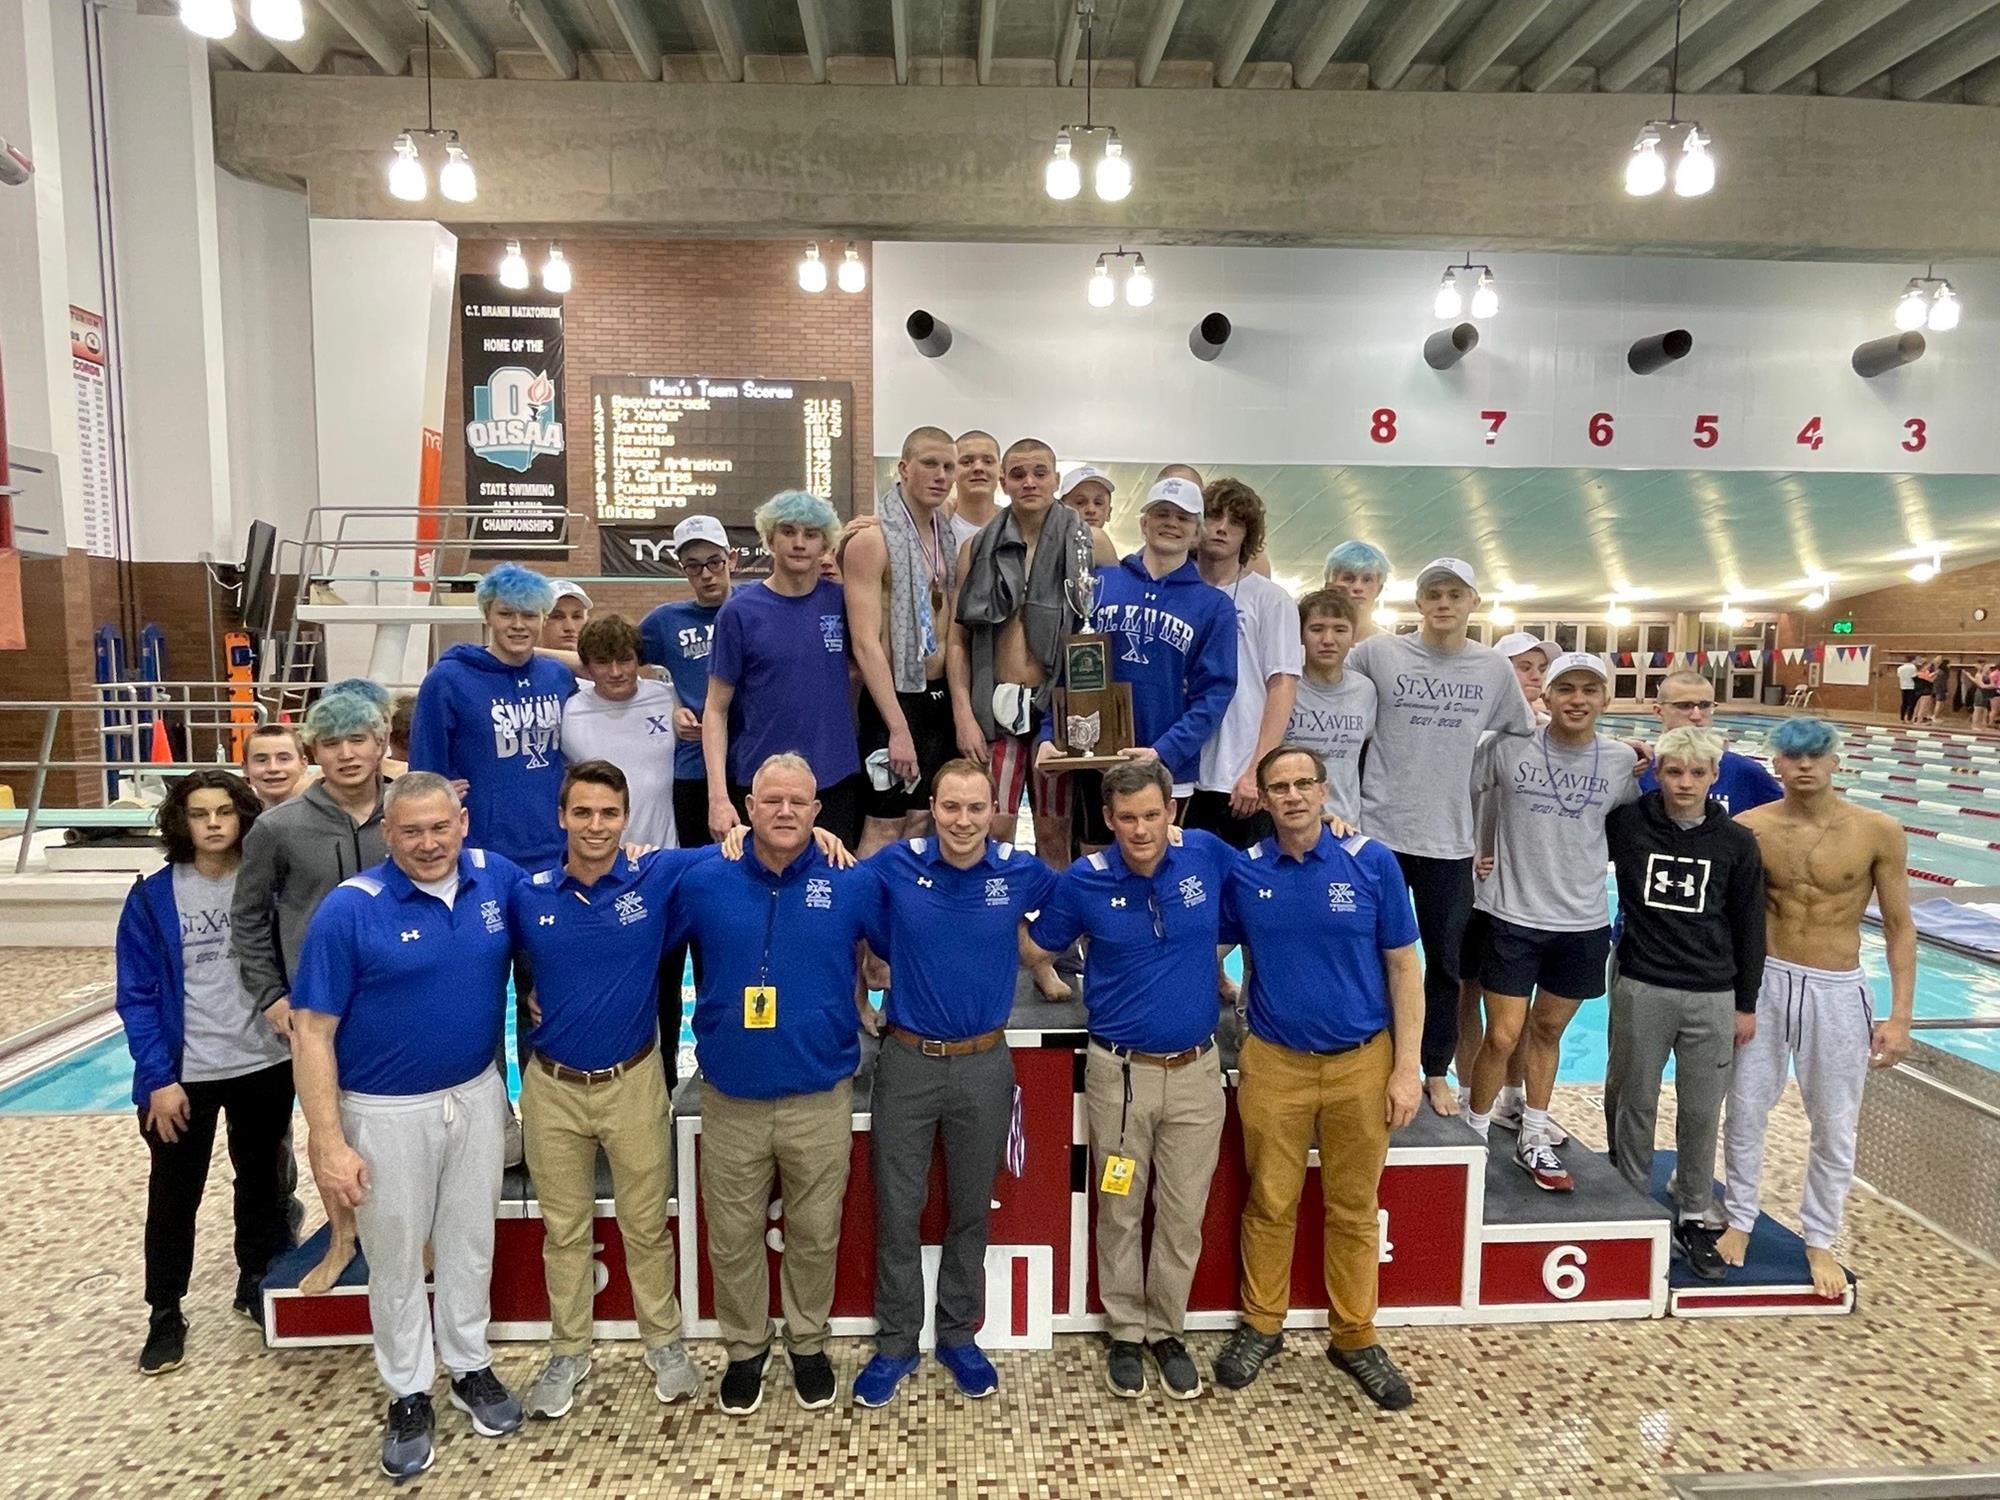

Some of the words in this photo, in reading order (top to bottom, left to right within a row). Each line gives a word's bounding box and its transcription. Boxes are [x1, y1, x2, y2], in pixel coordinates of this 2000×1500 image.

[483, 339, 510, 352] HOME
[511, 340, 524, 352] OF
[526, 340, 544, 352] THE
[697, 380, 738, 398] Team
[742, 381, 794, 399] Scores
[466, 420, 564, 451] OHSAA
[1371, 408, 1397, 443] 8
[1481, 411, 1507, 445] 7
[1588, 412, 1614, 447] 6
[1693, 415, 1719, 448] 5
[1796, 416, 1824, 450] 4
[1901, 418, 1927, 452] 3
[480, 483, 507, 495] STATE
[508, 484, 555, 497] SWIMMING
[482, 519, 555, 533] CHAMPIONSHIPS
[1542, 1245, 1587, 1299] 6
